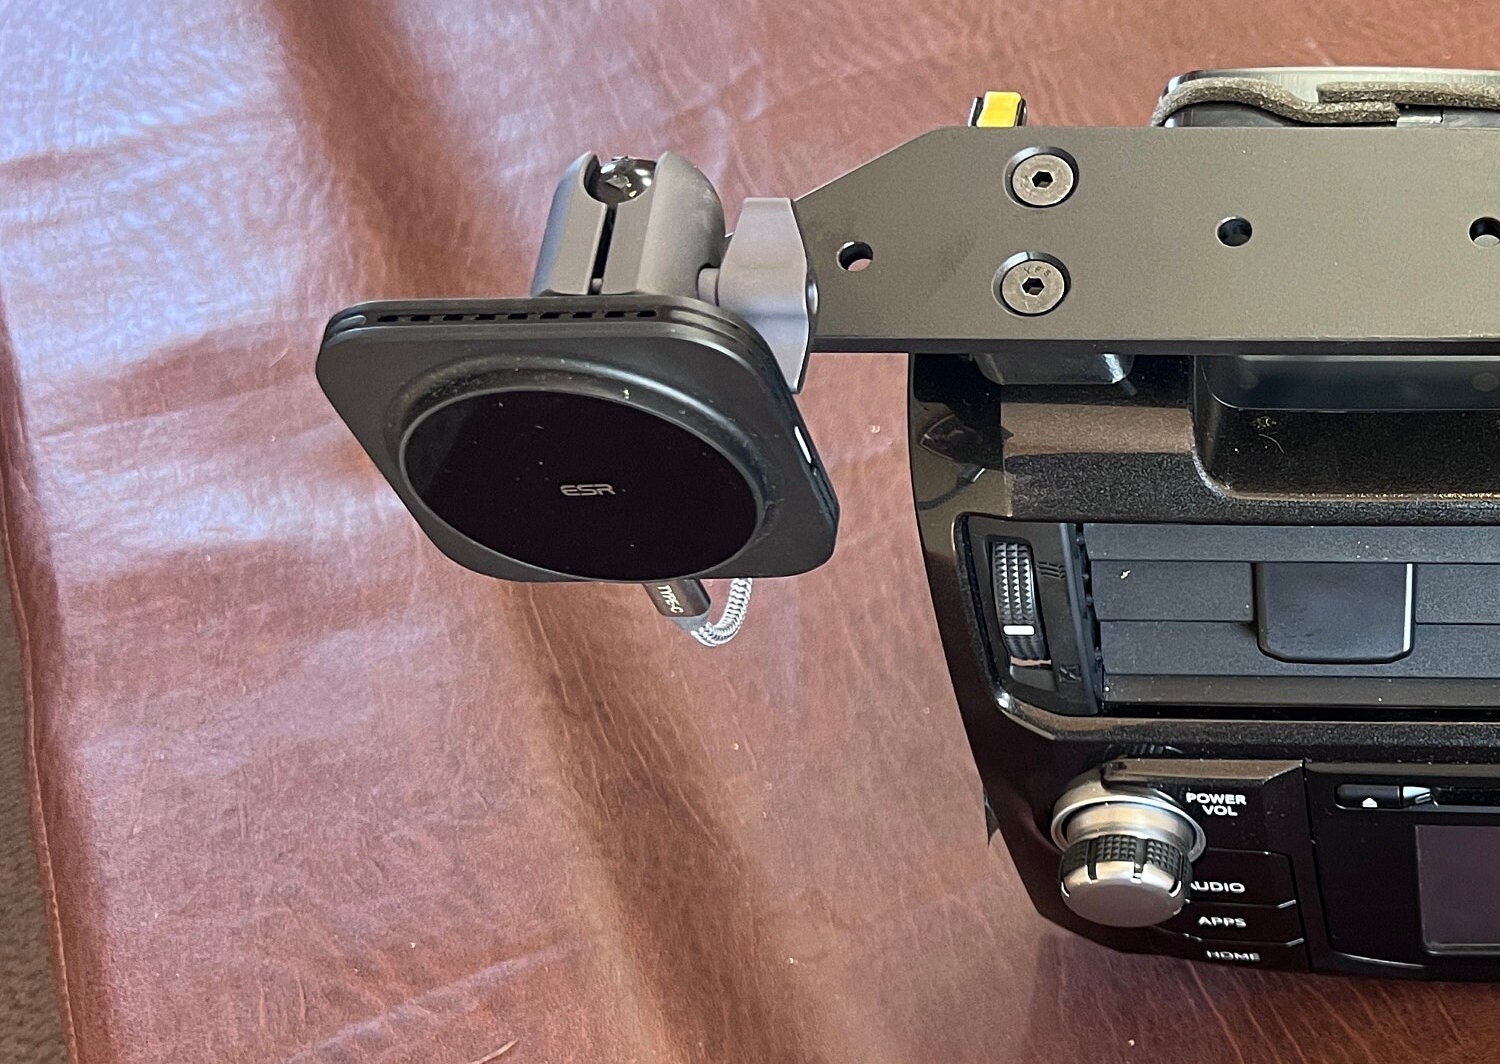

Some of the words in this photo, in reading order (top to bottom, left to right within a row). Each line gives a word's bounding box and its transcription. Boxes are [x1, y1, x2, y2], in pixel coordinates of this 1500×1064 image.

[560, 483, 616, 497] ESR
[656, 584, 685, 614] TYPE-C
[1185, 791, 1247, 806] POWER
[1201, 804, 1238, 817] VOL
[1198, 916, 1247, 928] APPS
[1206, 950, 1261, 961] HOME
